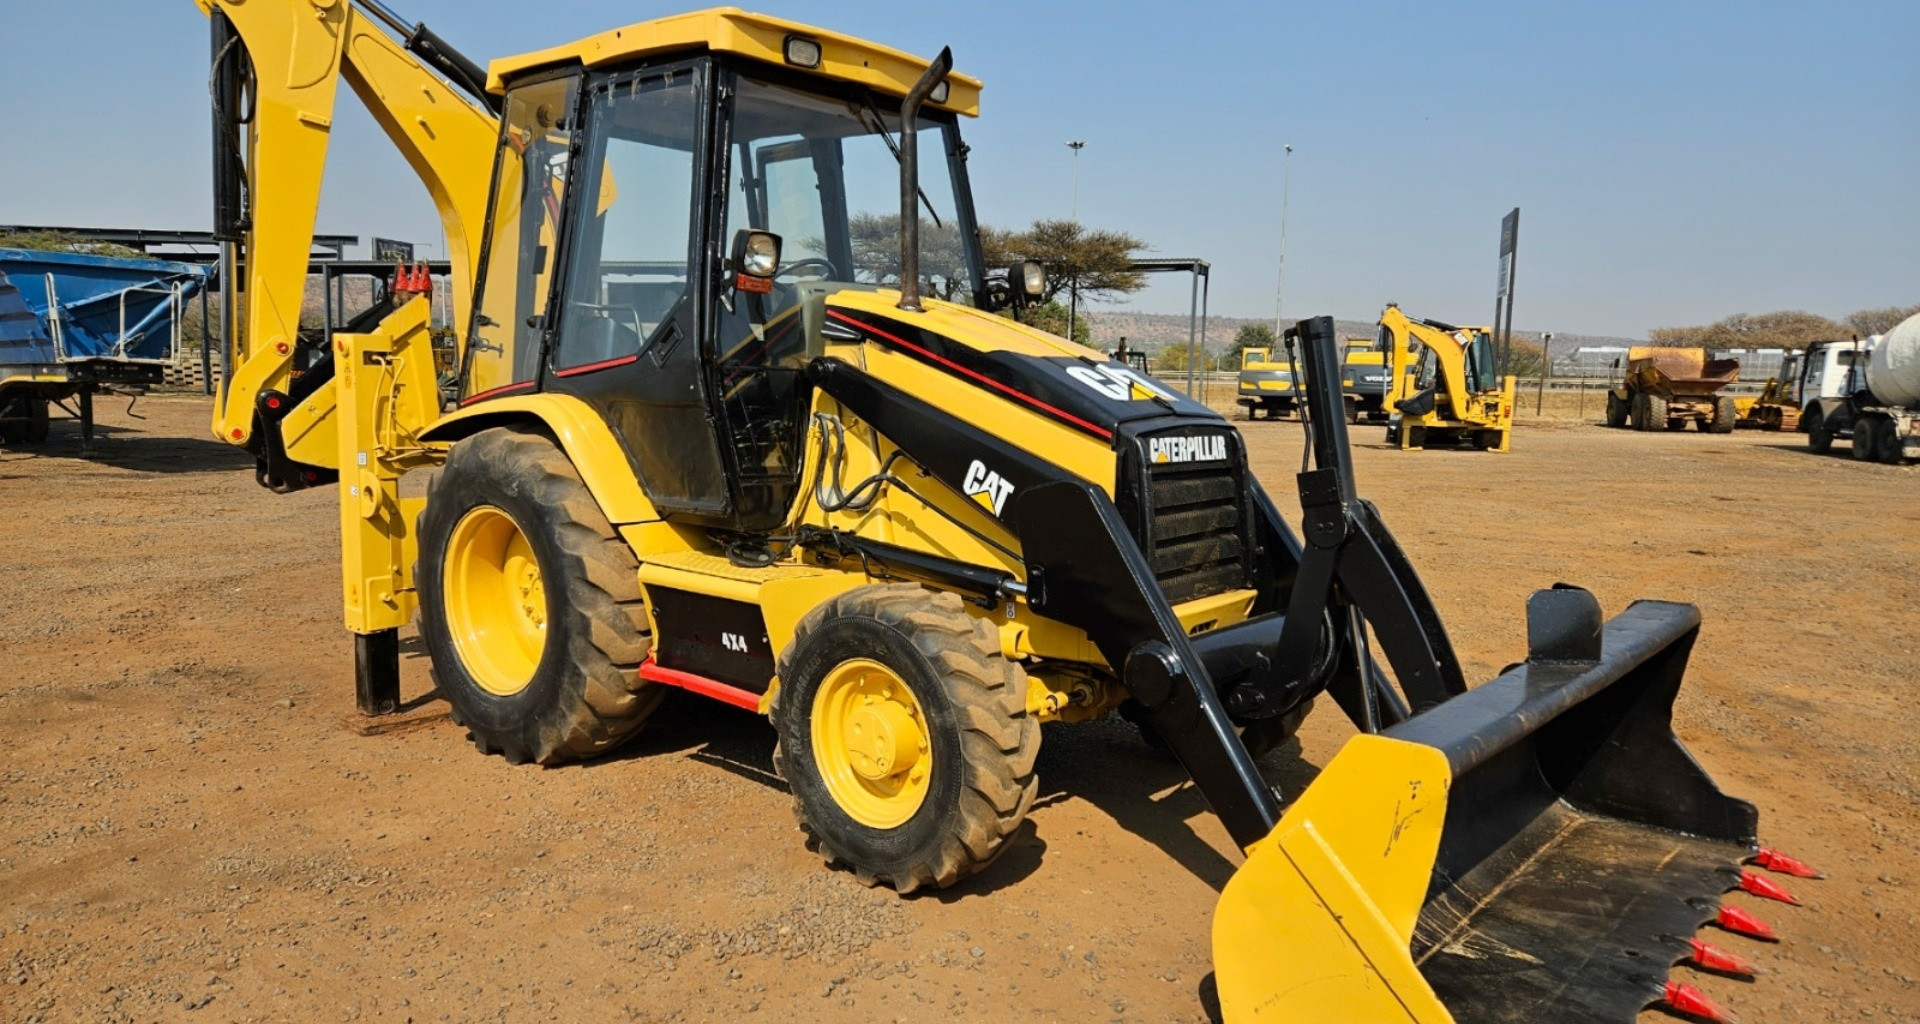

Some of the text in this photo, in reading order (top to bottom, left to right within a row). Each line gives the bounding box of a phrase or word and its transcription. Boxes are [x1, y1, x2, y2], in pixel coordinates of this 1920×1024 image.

[1066, 364, 1180, 402] CAT
[1150, 435, 1227, 464] CATERPILLAR
[963, 459, 1015, 518] CAT
[722, 632, 748, 653] 4X4
